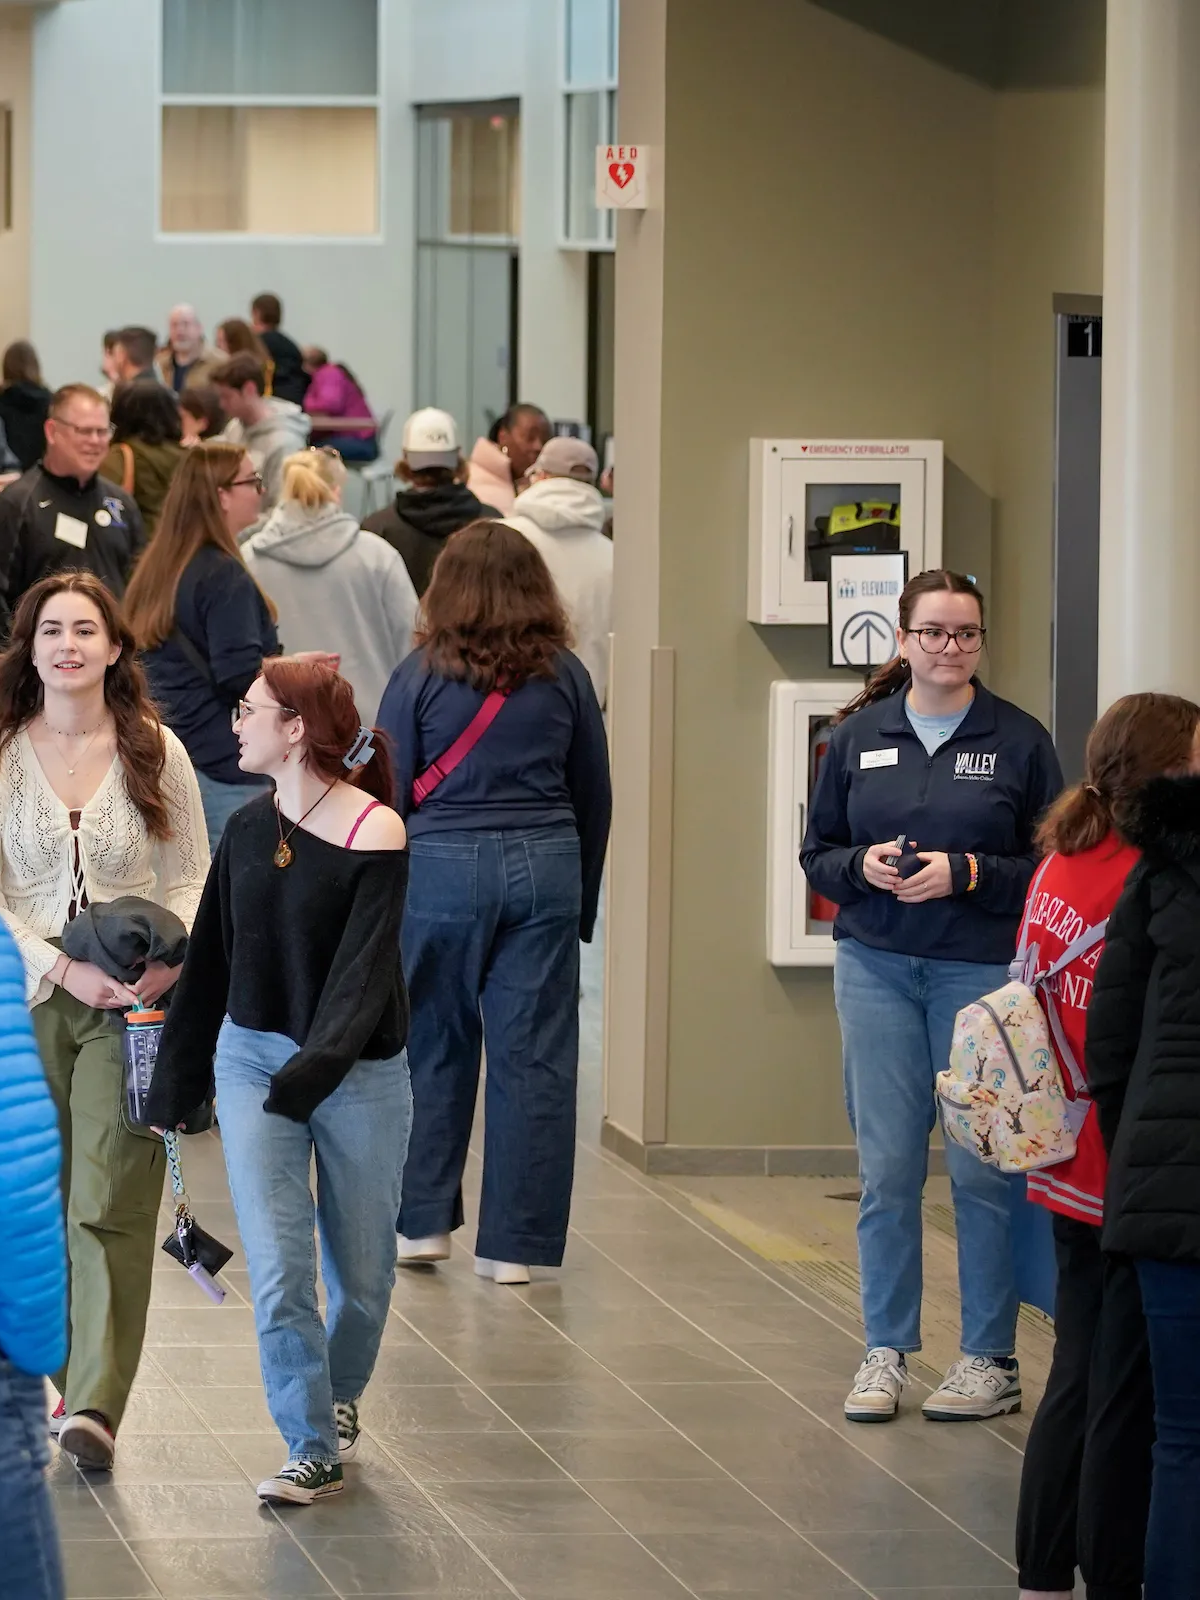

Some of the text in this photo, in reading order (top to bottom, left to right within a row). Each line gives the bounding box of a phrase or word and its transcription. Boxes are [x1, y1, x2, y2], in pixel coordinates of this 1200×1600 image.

[606, 147, 637, 160] AED
[1084, 322, 1092, 357] 1
[809, 445, 909, 454] EMERGENCY DEFIBRILLATOR
[861, 580, 899, 596] ELEVATOR
[954, 752, 997, 775] VALLEY
